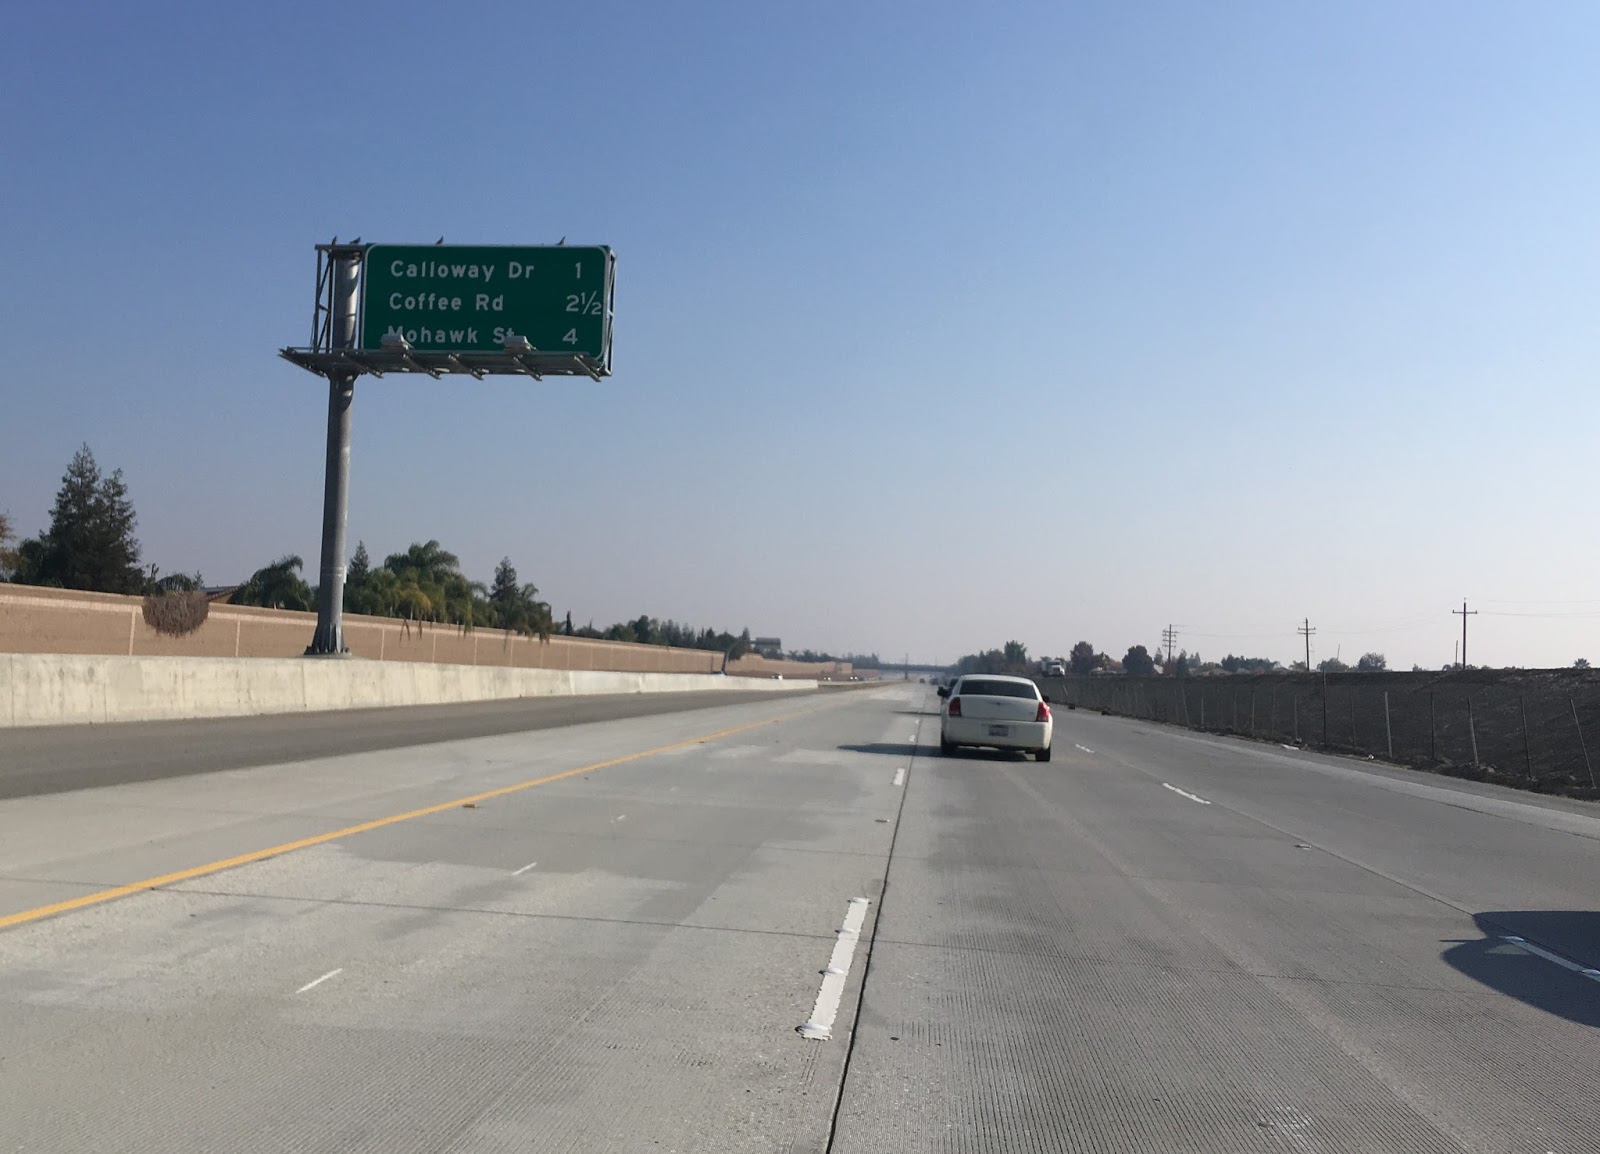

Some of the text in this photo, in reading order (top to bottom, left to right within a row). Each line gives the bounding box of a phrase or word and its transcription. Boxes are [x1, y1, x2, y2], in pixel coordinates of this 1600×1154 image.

[390, 260, 582, 282] Calloway Dr 1
[389, 292, 462, 310] Coffee
[475, 294, 504, 311] Rd
[562, 328, 578, 345] 4
